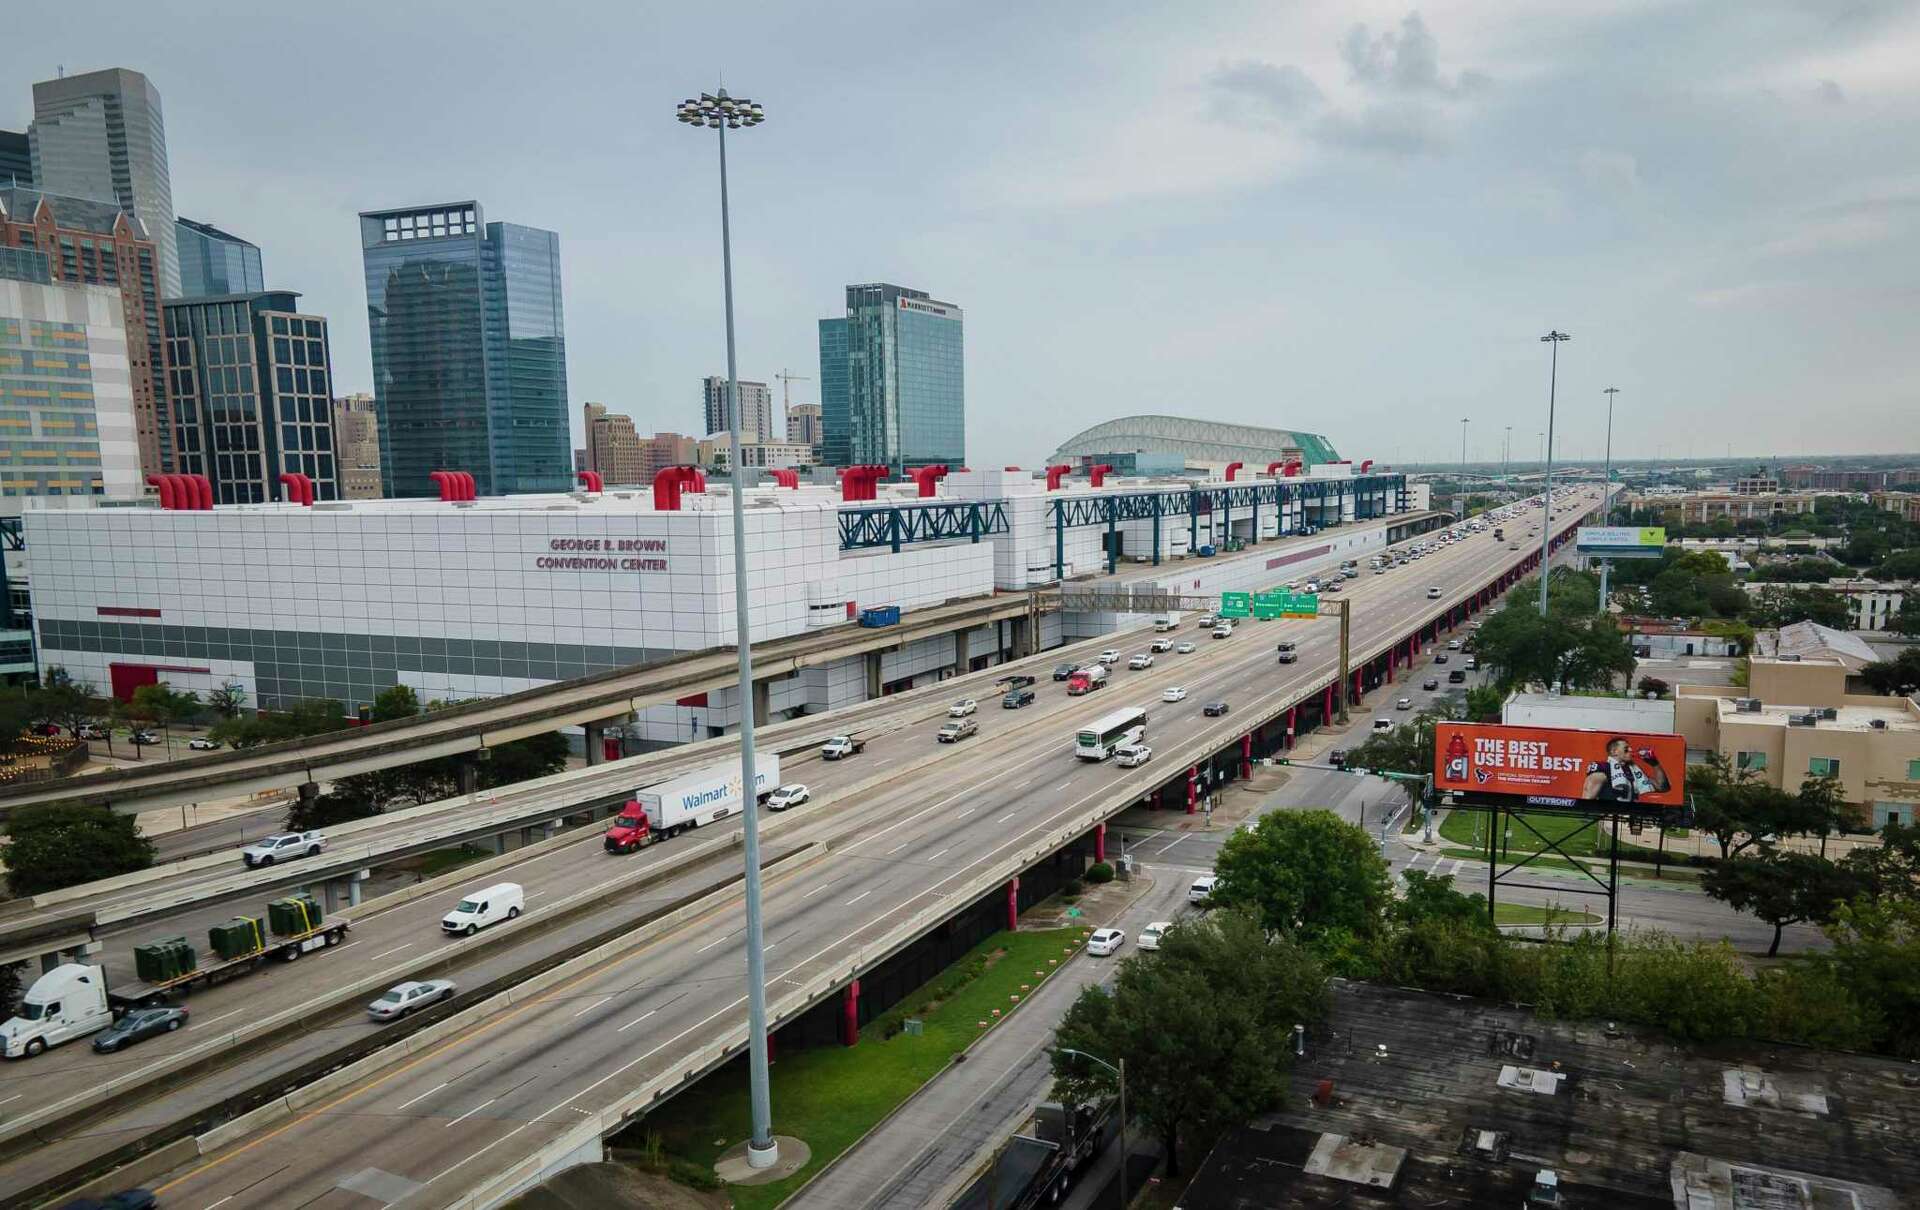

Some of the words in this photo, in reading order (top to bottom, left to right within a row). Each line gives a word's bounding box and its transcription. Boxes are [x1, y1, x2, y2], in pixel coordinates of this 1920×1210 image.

[550, 539, 600, 550] GEORGE
[604, 540, 614, 551] R.
[618, 540, 667, 552] BROWN
[536, 557, 617, 570] CONVENTION
[621, 558, 667, 571] CENTER
[1474, 738, 1505, 753] THE
[1508, 740, 1548, 755] BEST
[1451, 759, 1463, 771] G
[1474, 751, 1505, 767] USE
[1508, 754, 1538, 769] THE
[1542, 756, 1583, 772] BEST
[682, 784, 729, 810] Walmart
[1529, 797, 1574, 806] OUTFRONT
